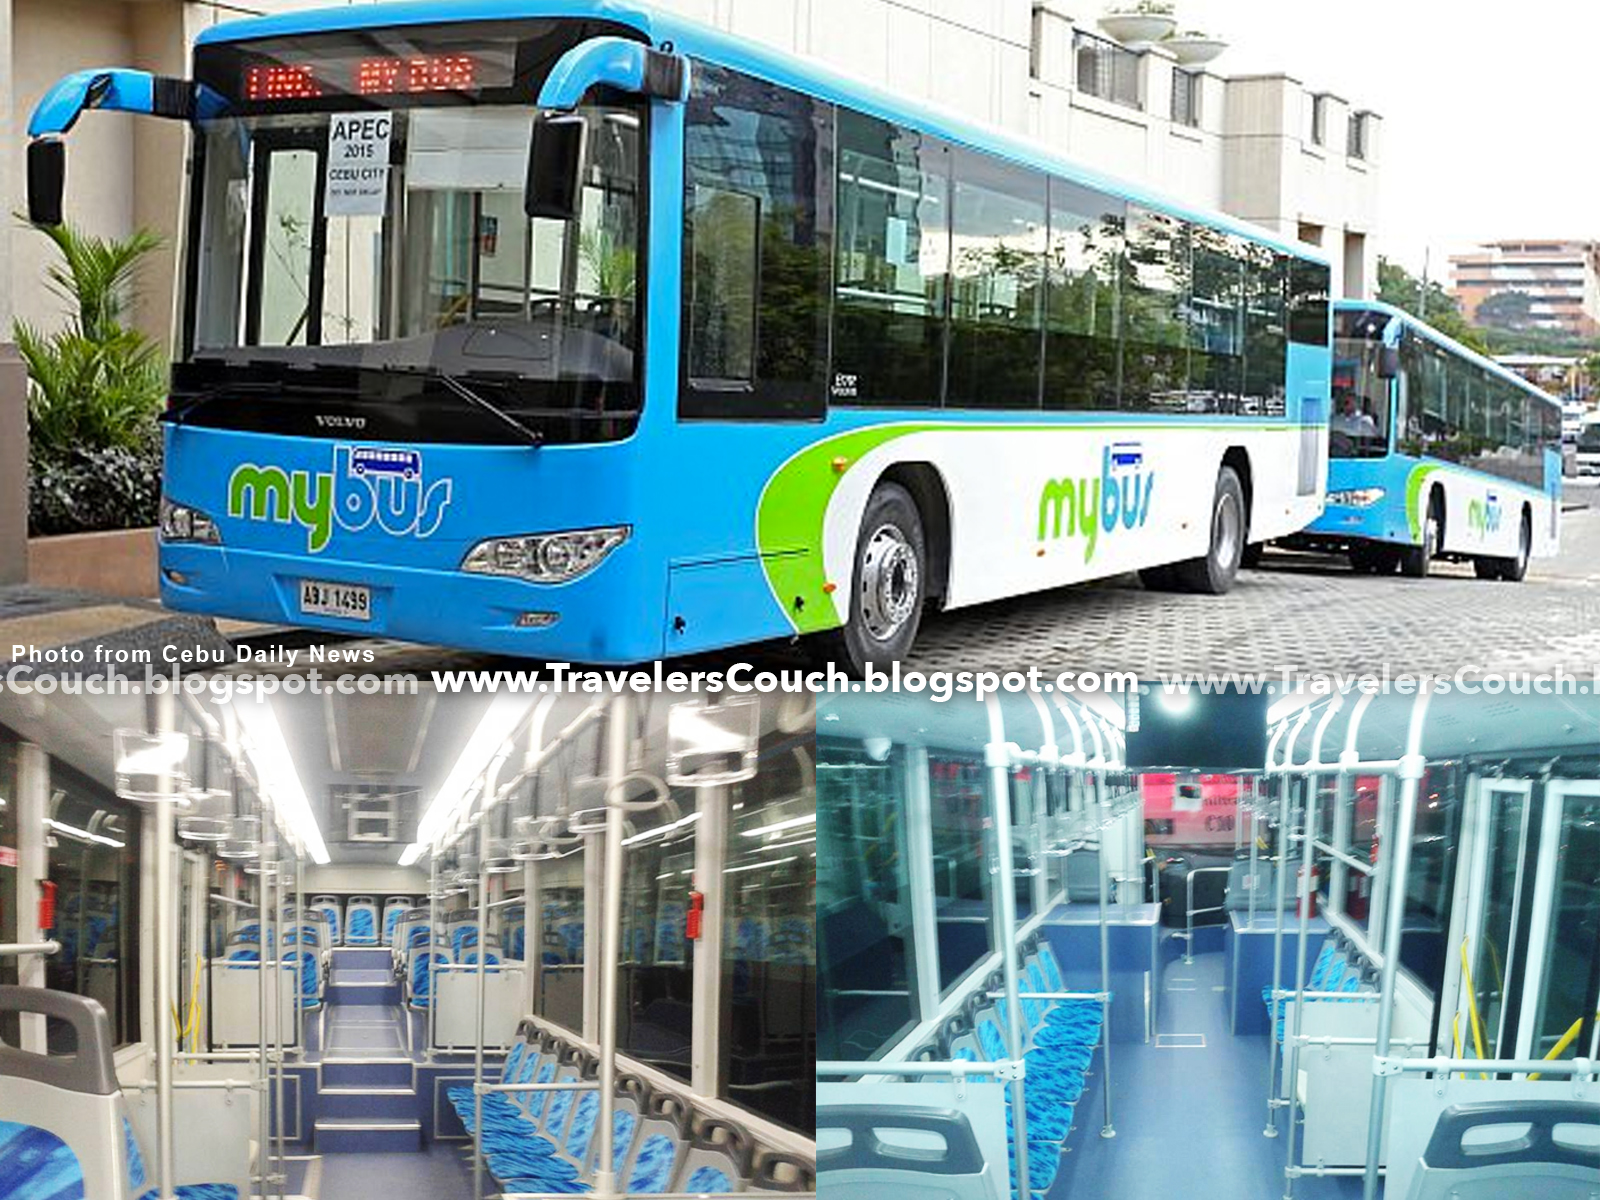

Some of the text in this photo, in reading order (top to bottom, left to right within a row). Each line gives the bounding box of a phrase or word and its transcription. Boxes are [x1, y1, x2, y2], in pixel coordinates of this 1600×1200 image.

[332, 119, 390, 141] APEC
[344, 143, 375, 158] 2015
[315, 415, 367, 429] VOLVO
